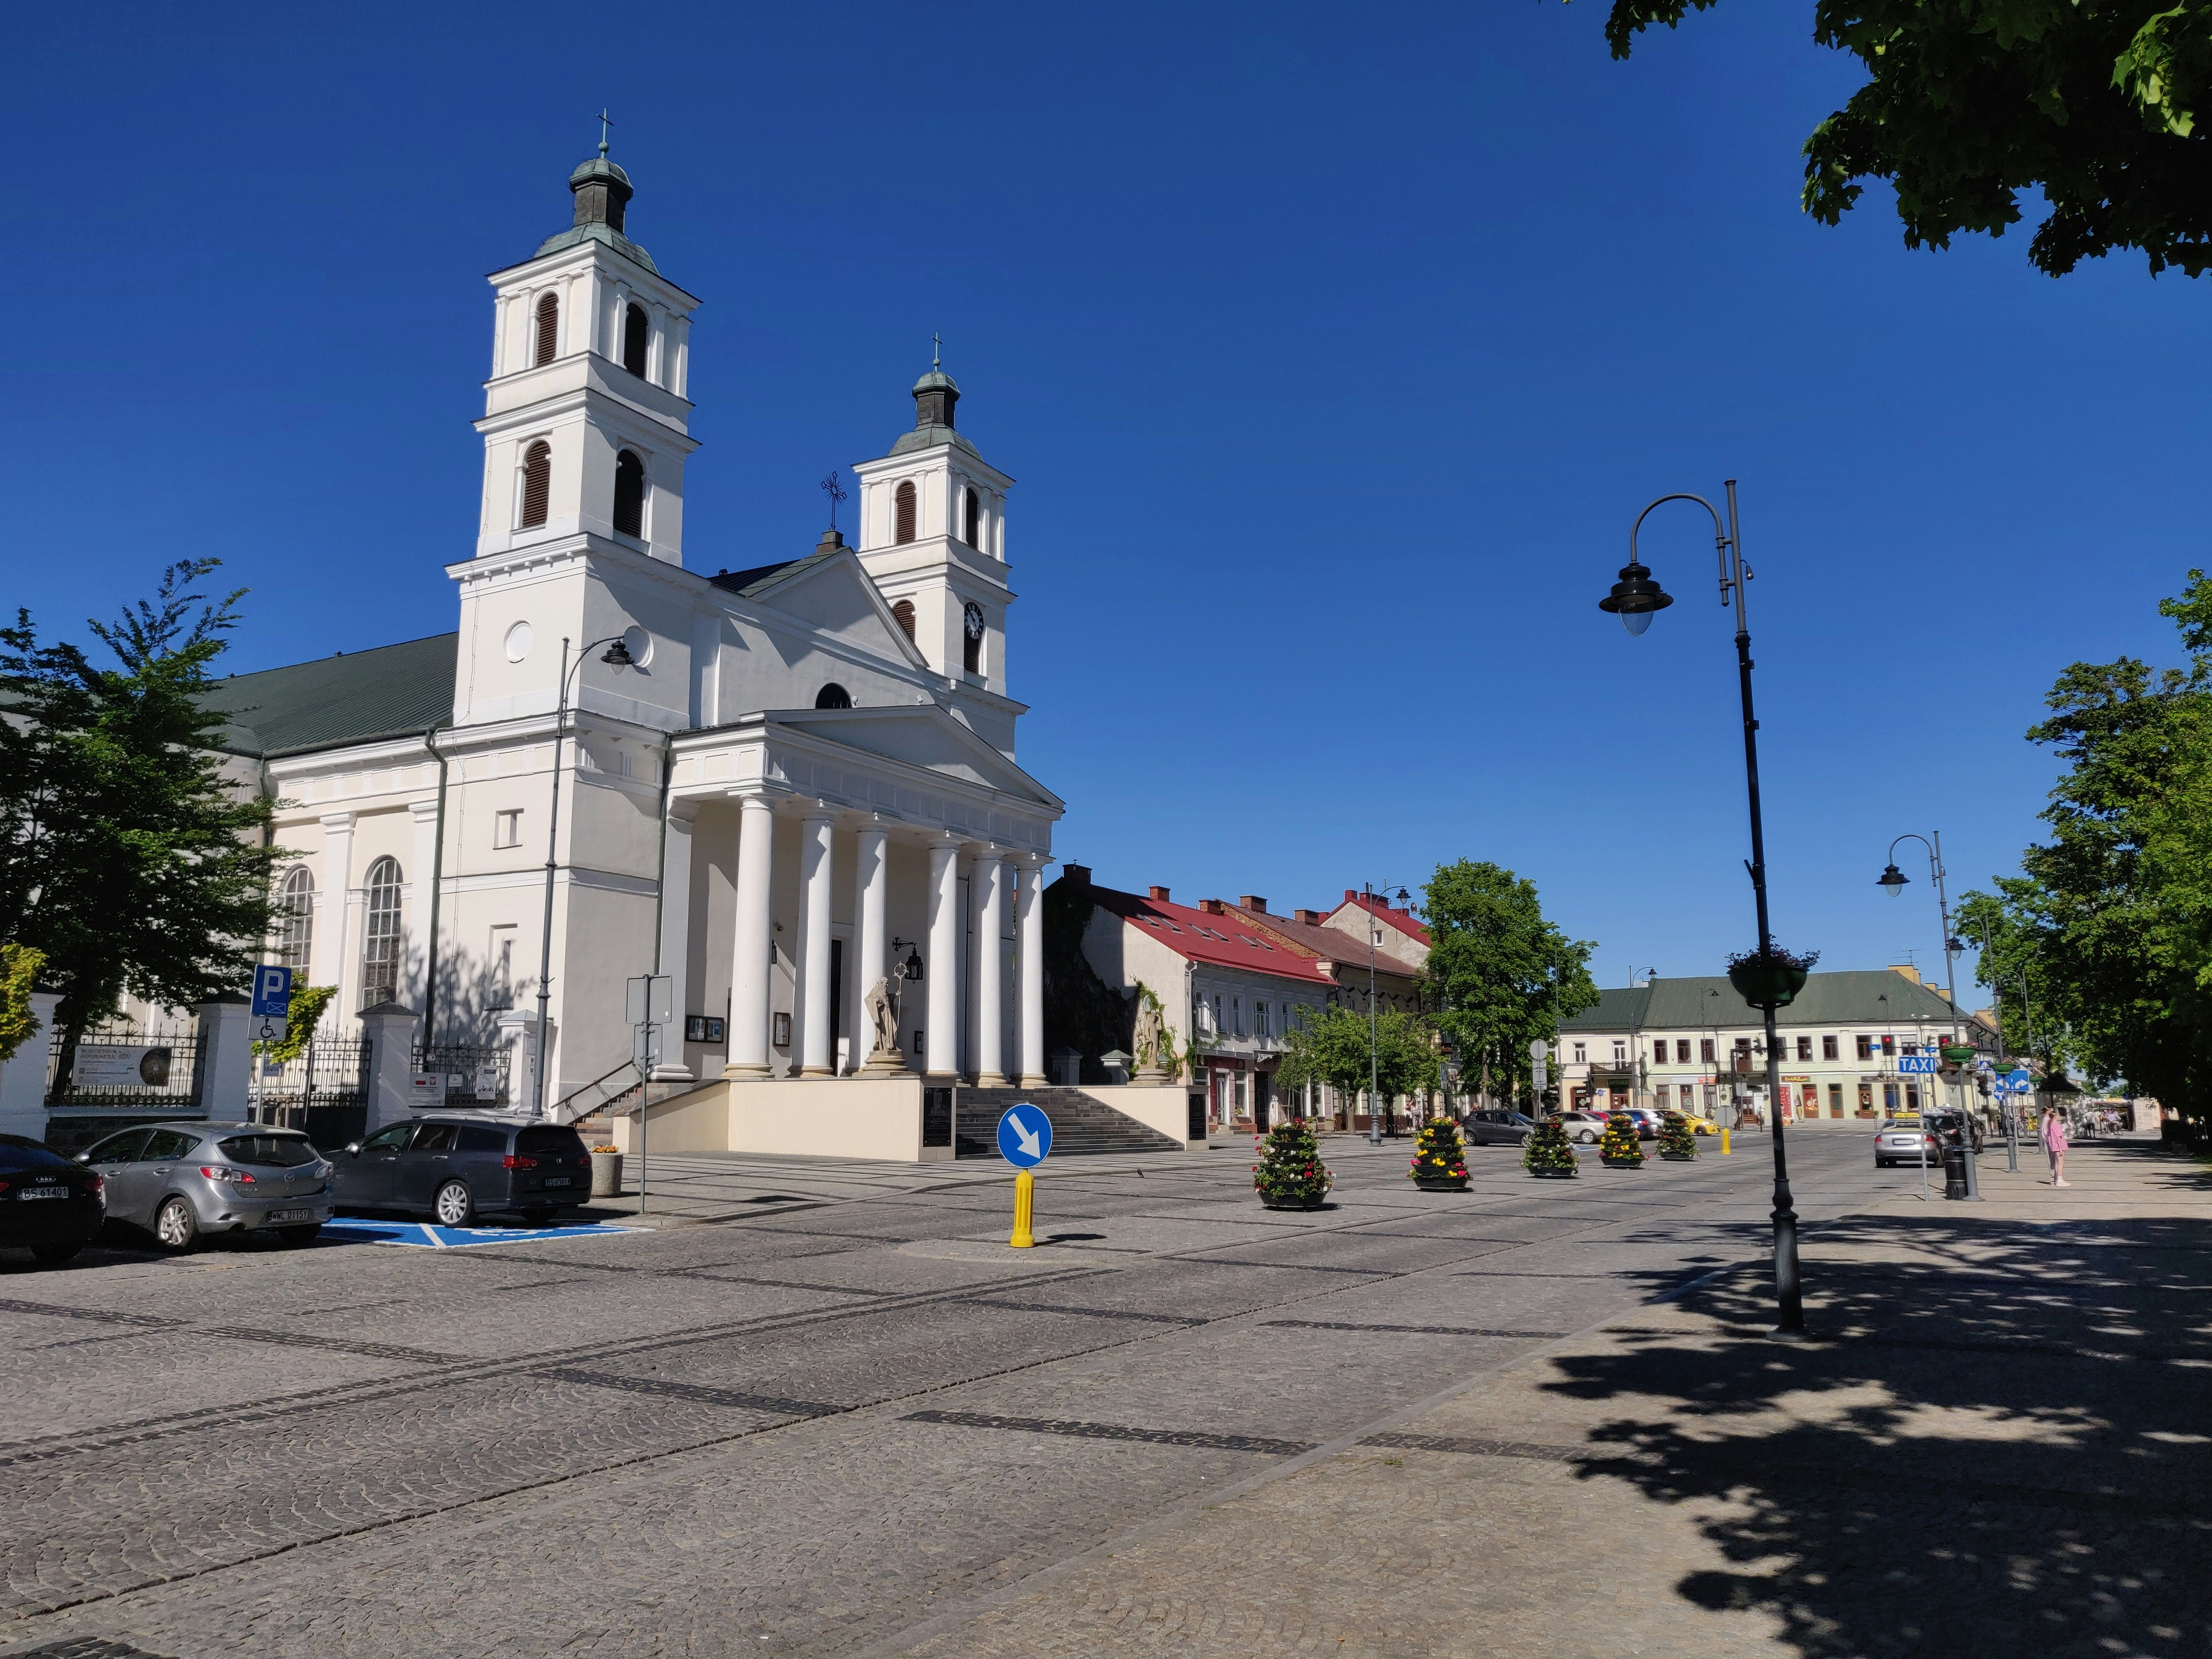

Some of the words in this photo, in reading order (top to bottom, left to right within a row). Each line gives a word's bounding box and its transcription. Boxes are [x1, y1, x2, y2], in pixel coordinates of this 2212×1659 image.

[262, 970, 284, 1000] P
[1899, 1058, 1934, 1071] TAXI
[24, 1189, 37, 1198] BS
